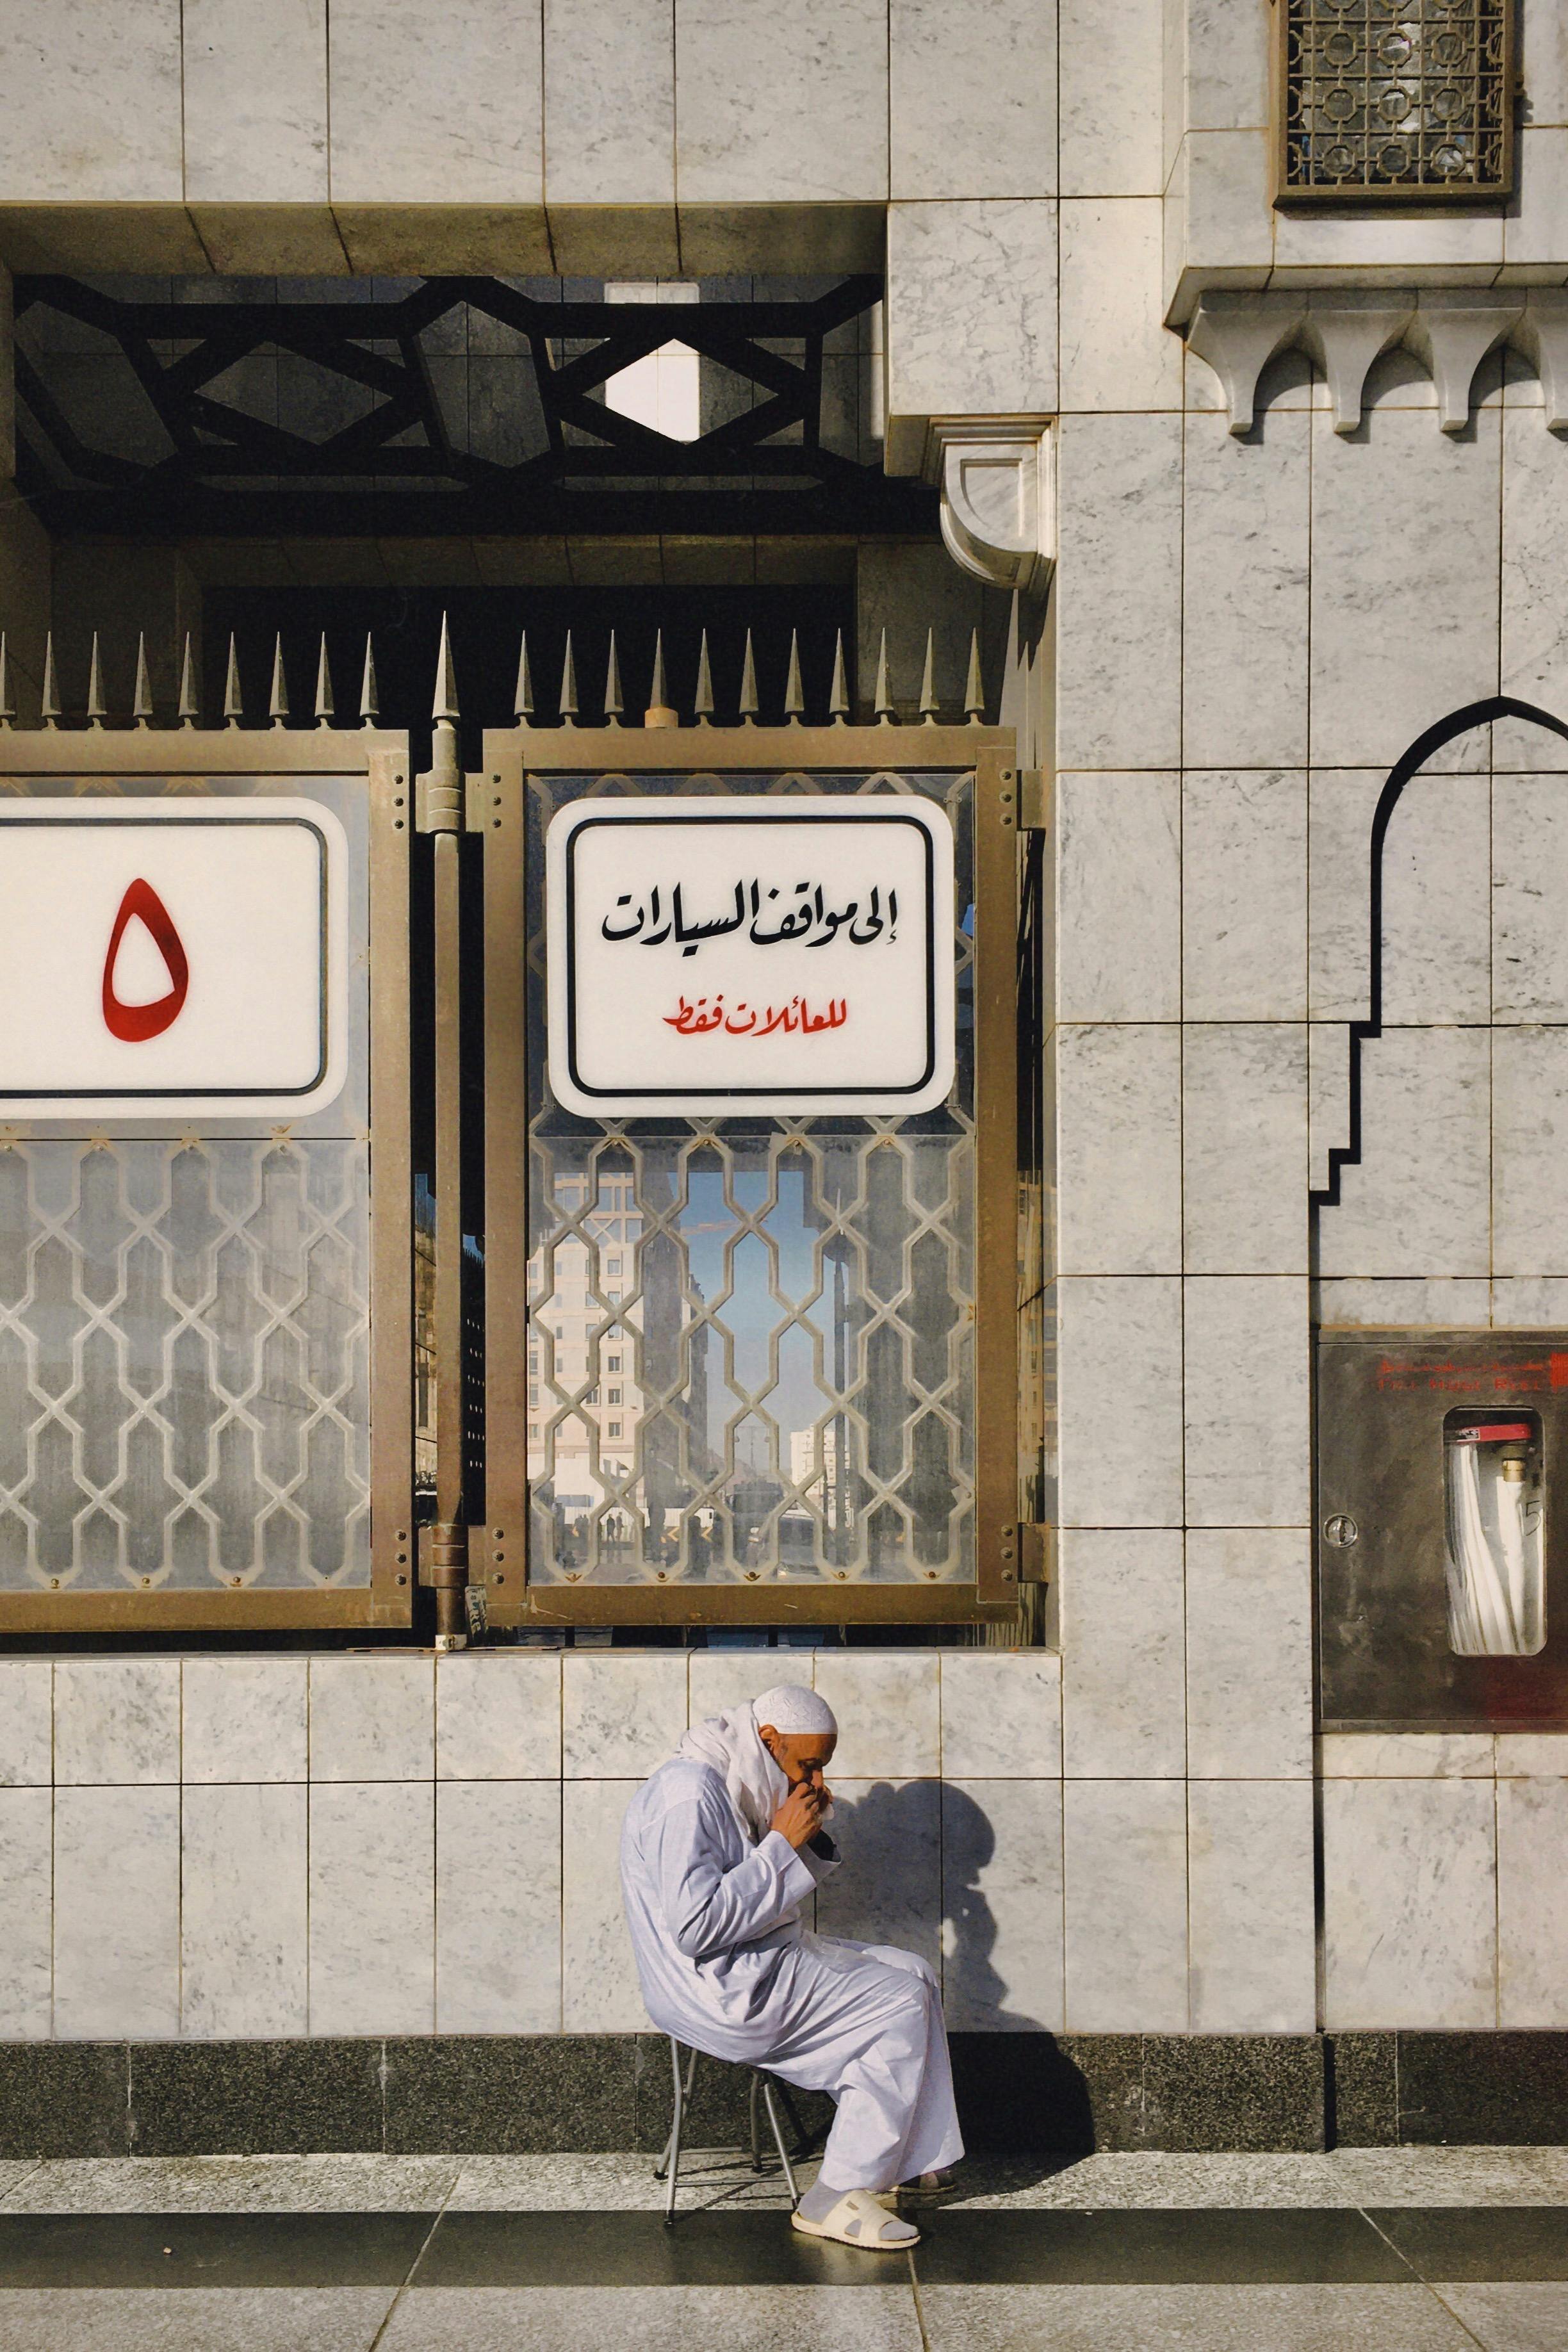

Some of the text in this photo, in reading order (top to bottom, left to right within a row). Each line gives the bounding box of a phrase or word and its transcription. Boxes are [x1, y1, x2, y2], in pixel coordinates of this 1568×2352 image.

[601, 878, 898, 958] إلى مواقف السيارات
[101, 878, 190, 1044] ٥
[662, 994, 848, 1037] للعائلات فقط
[1525, 1499, 1542, 1537] 5
